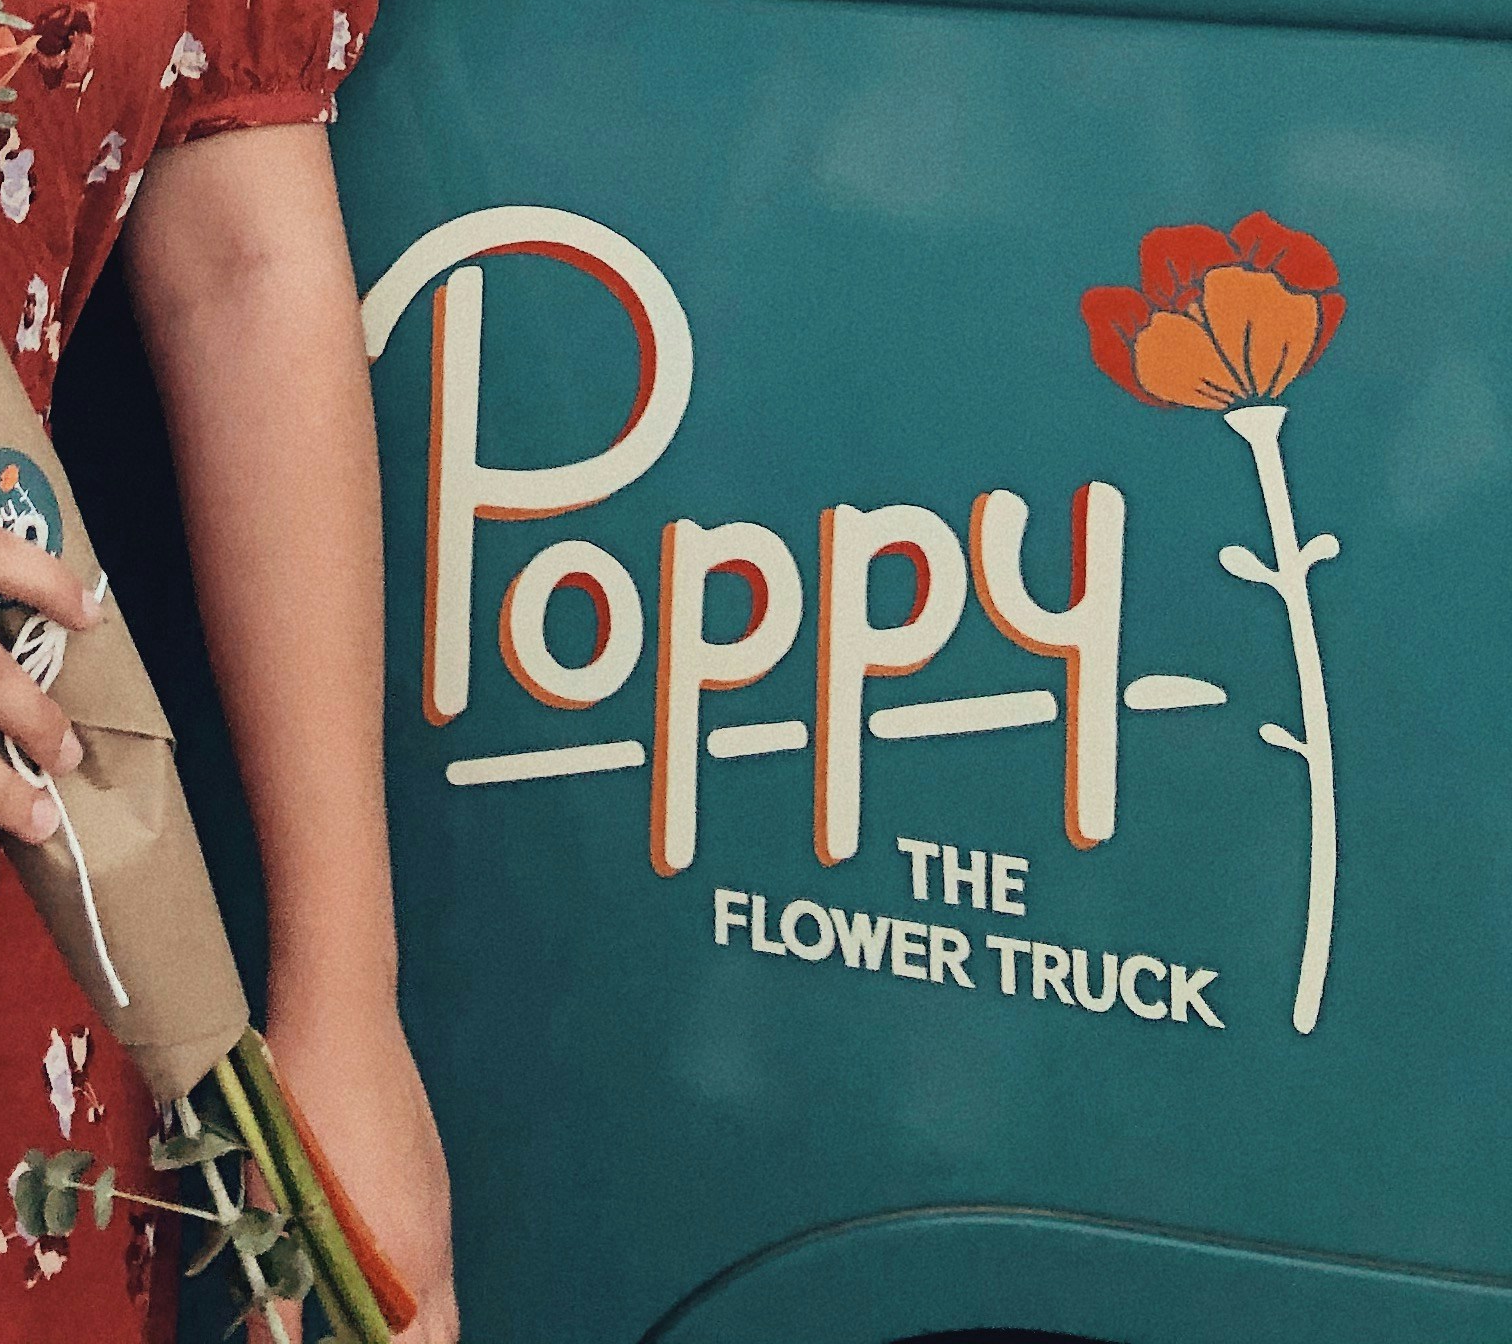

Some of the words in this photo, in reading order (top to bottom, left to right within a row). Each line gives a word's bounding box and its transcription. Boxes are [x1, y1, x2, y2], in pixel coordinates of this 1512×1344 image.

[360, 204, 1127, 878] Poppy
[896, 836, 1030, 917] THE
[713, 887, 976, 989] FLOWER
[985, 933, 1226, 1031] TRUCK
